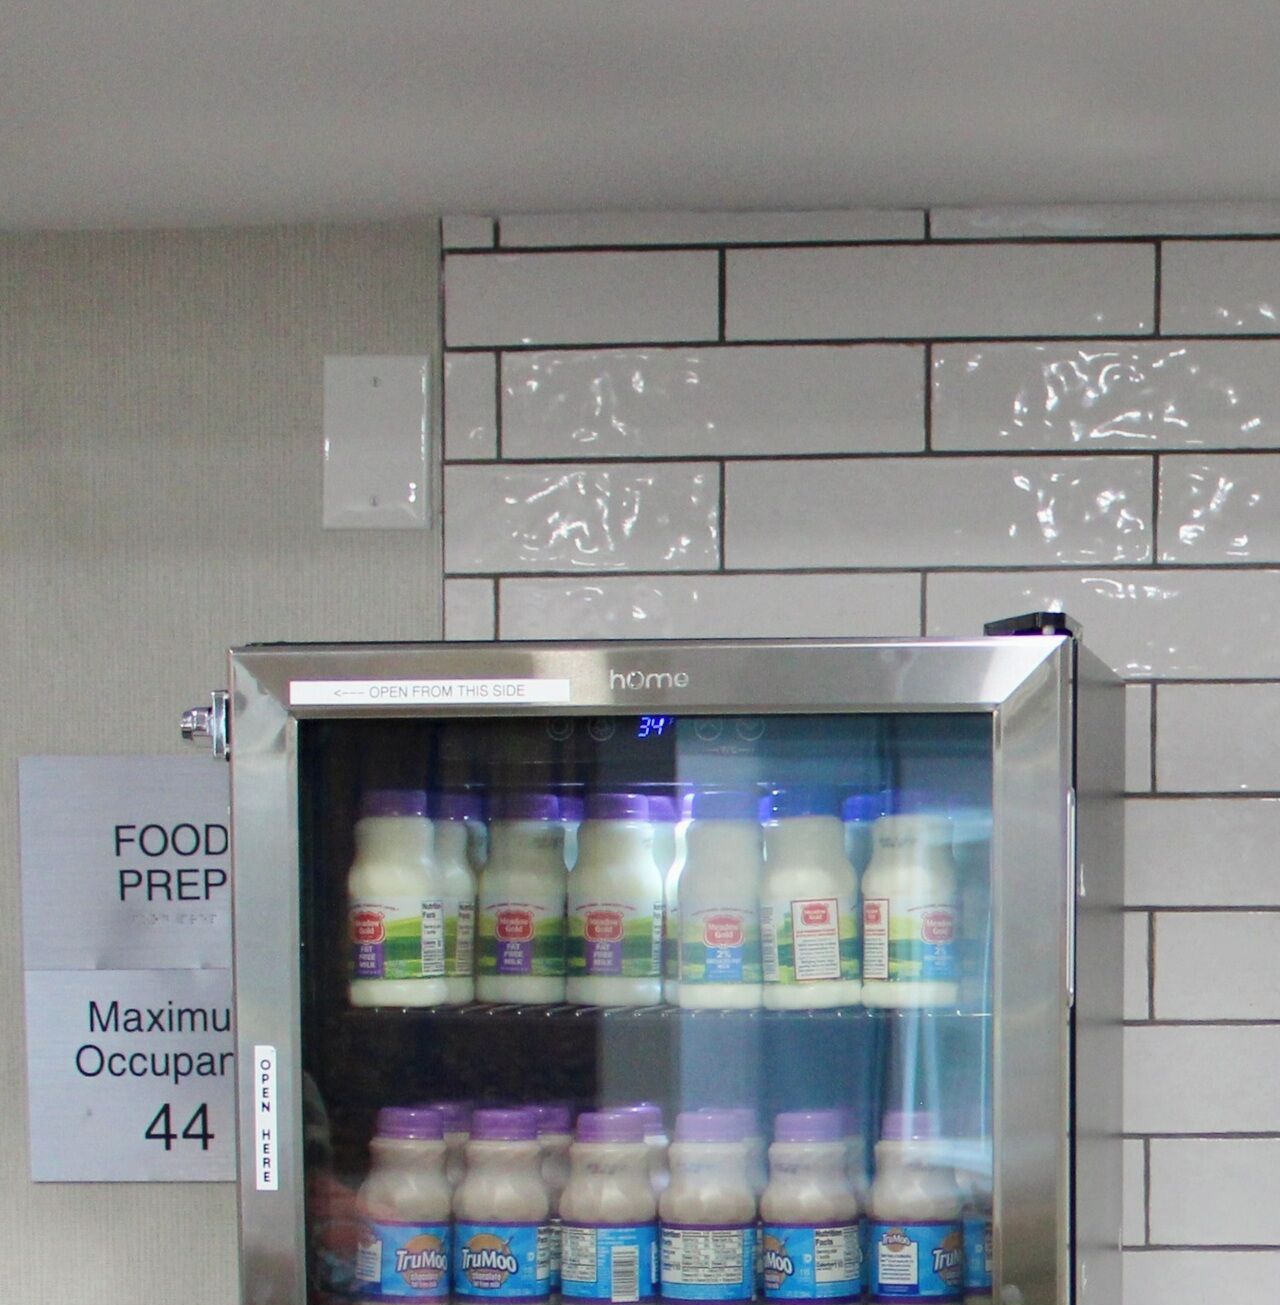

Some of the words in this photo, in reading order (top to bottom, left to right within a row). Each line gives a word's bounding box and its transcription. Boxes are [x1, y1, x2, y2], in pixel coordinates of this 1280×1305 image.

[369, 686, 408, 699] OPEN
[412, 685, 454, 698] FROM
[458, 685, 490, 698] THIS
[493, 684, 526, 698] SIDE
[609, 668, 689, 691] home
[638, 716, 665, 737] 34
[114, 823, 228, 857] FOOD
[119, 868, 228, 901] PREP
[89, 1000, 232, 1033] Maximu
[260, 1059, 272, 1112] OPEN
[145, 1103, 215, 1151] 44
[262, 1129, 272, 1183] HERE
[462, 1248, 518, 1273] TruMoo
